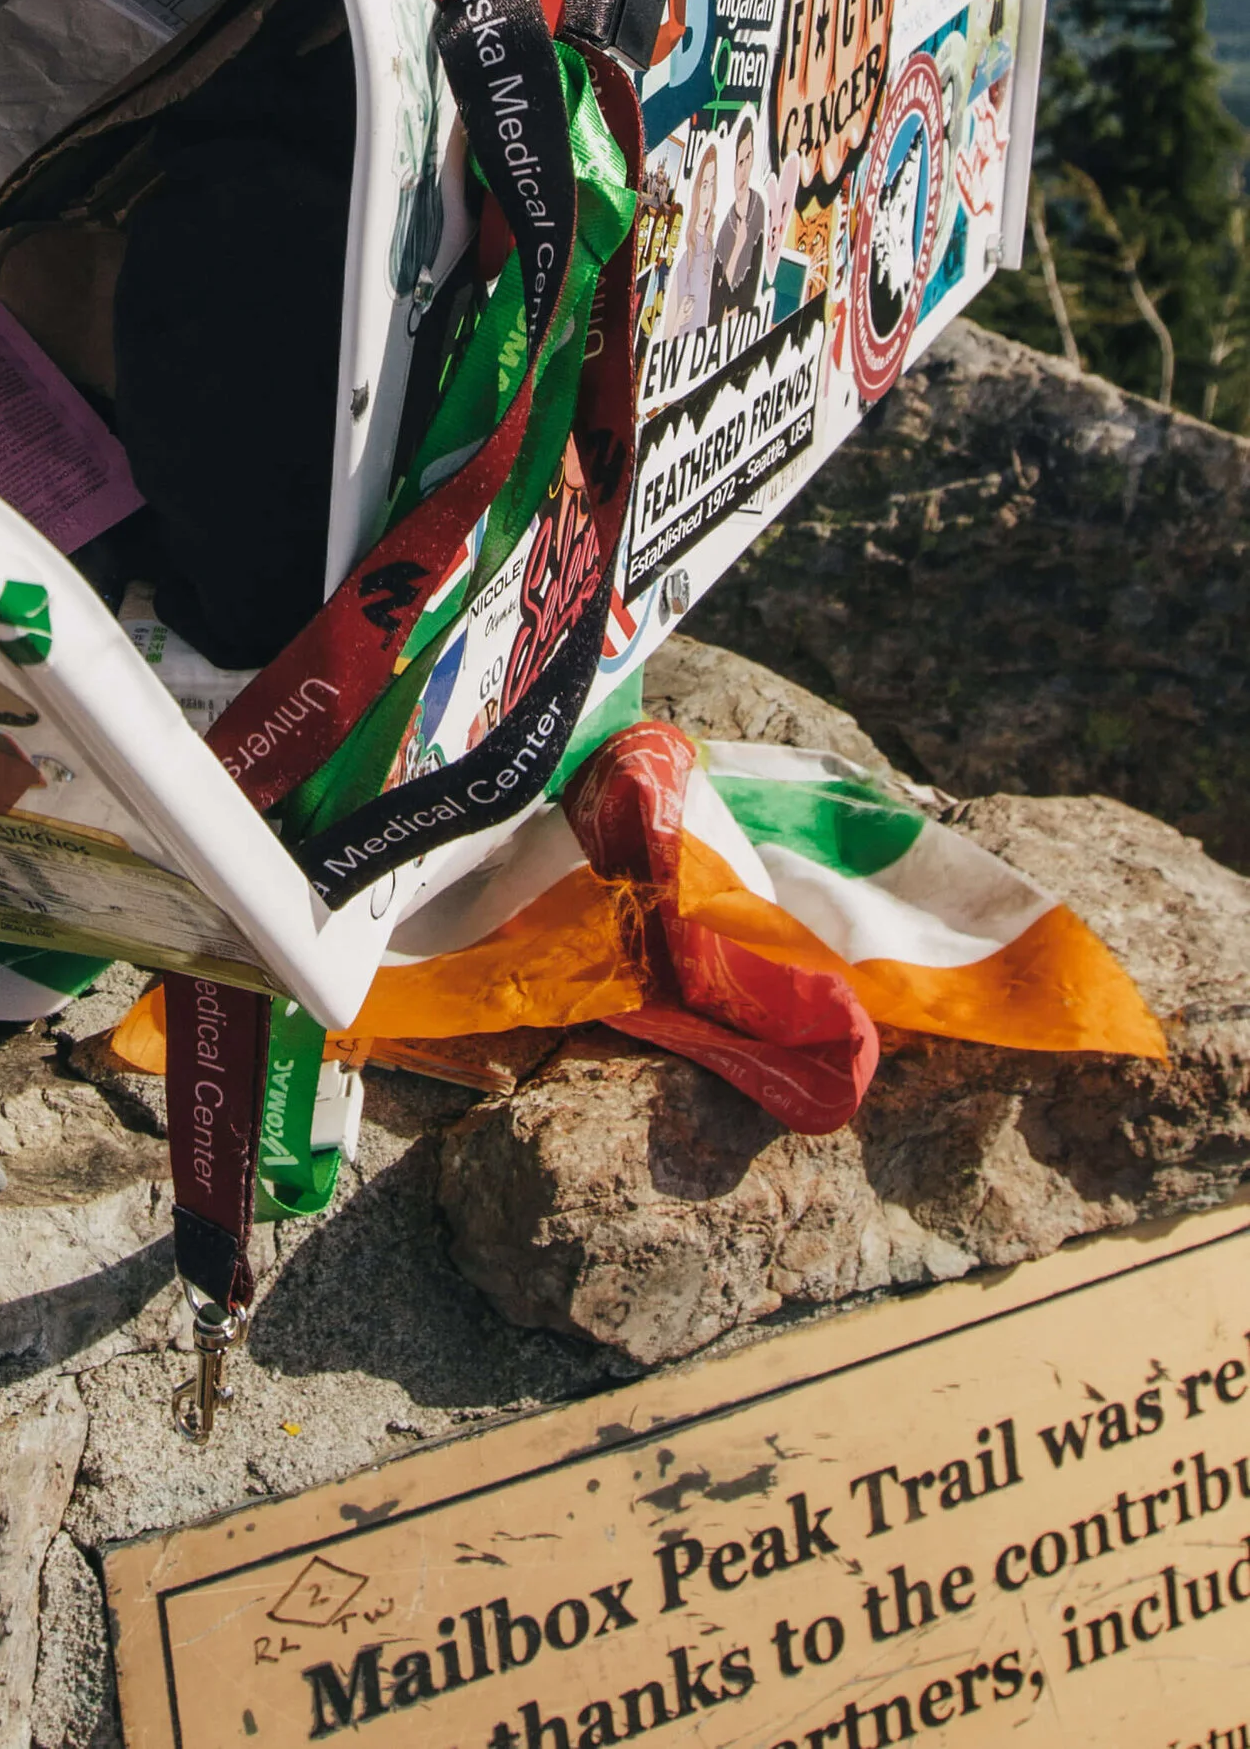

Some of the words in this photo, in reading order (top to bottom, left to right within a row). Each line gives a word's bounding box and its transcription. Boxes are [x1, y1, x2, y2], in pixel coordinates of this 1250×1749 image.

[488, 73, 556, 228] Medical
[780, 44, 882, 163] CANCER
[865, 77, 916, 218] AMERICAN
[915, 72, 940, 140] ALPINE
[643, 332, 689, 401] EW
[628, 509, 704, 586] Established
[705, 473, 736, 521] 1972
[745, 438, 788, 485] Seattle,
[789, 412, 813, 446] USA
[640, 409, 747, 535] FEATHERED
[749, 355, 815, 447] FRIENDS
[323, 792, 466, 879] Medical
[467, 694, 563, 806] Center
[194, 978, 228, 1074] edical
[193, 1080, 225, 1195] Center
[301, 1578, 639, 1740] Mailbox
[653, 1492, 840, 1614] Peak
[850, 1418, 1024, 1538] Trail
[1038, 1387, 1164, 1469] was
[1183, 1332, 1250, 1420] re
[488, 1645, 759, 1749] thanks
[770, 1613, 845, 1679] to
[862, 1562, 977, 1643] the
[773, 1648, 1044, 1749] rtners,
